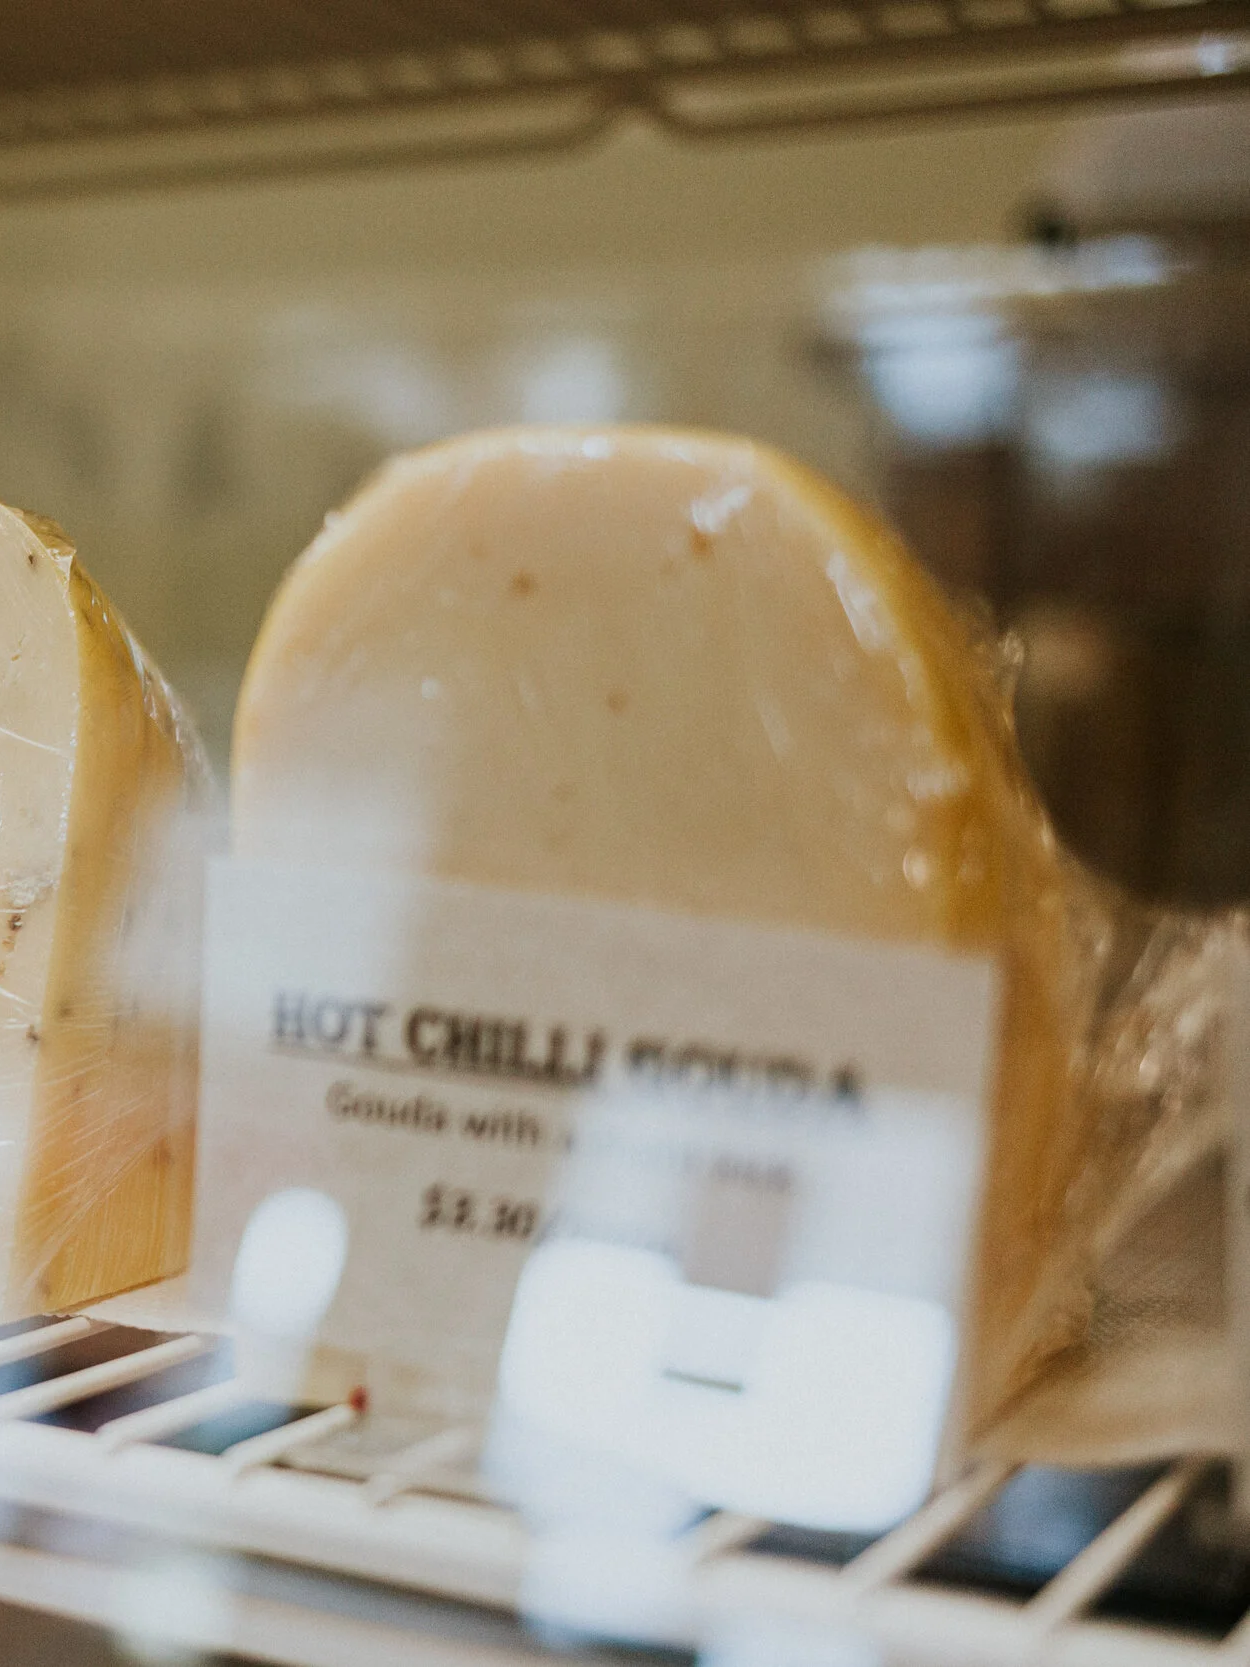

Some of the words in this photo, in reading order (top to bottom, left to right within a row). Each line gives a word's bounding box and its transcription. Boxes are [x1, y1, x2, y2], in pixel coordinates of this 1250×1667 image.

[272, 992, 390, 1052] HOT
[326, 1081, 451, 1134] Gouda
[463, 1107, 543, 1150] with
